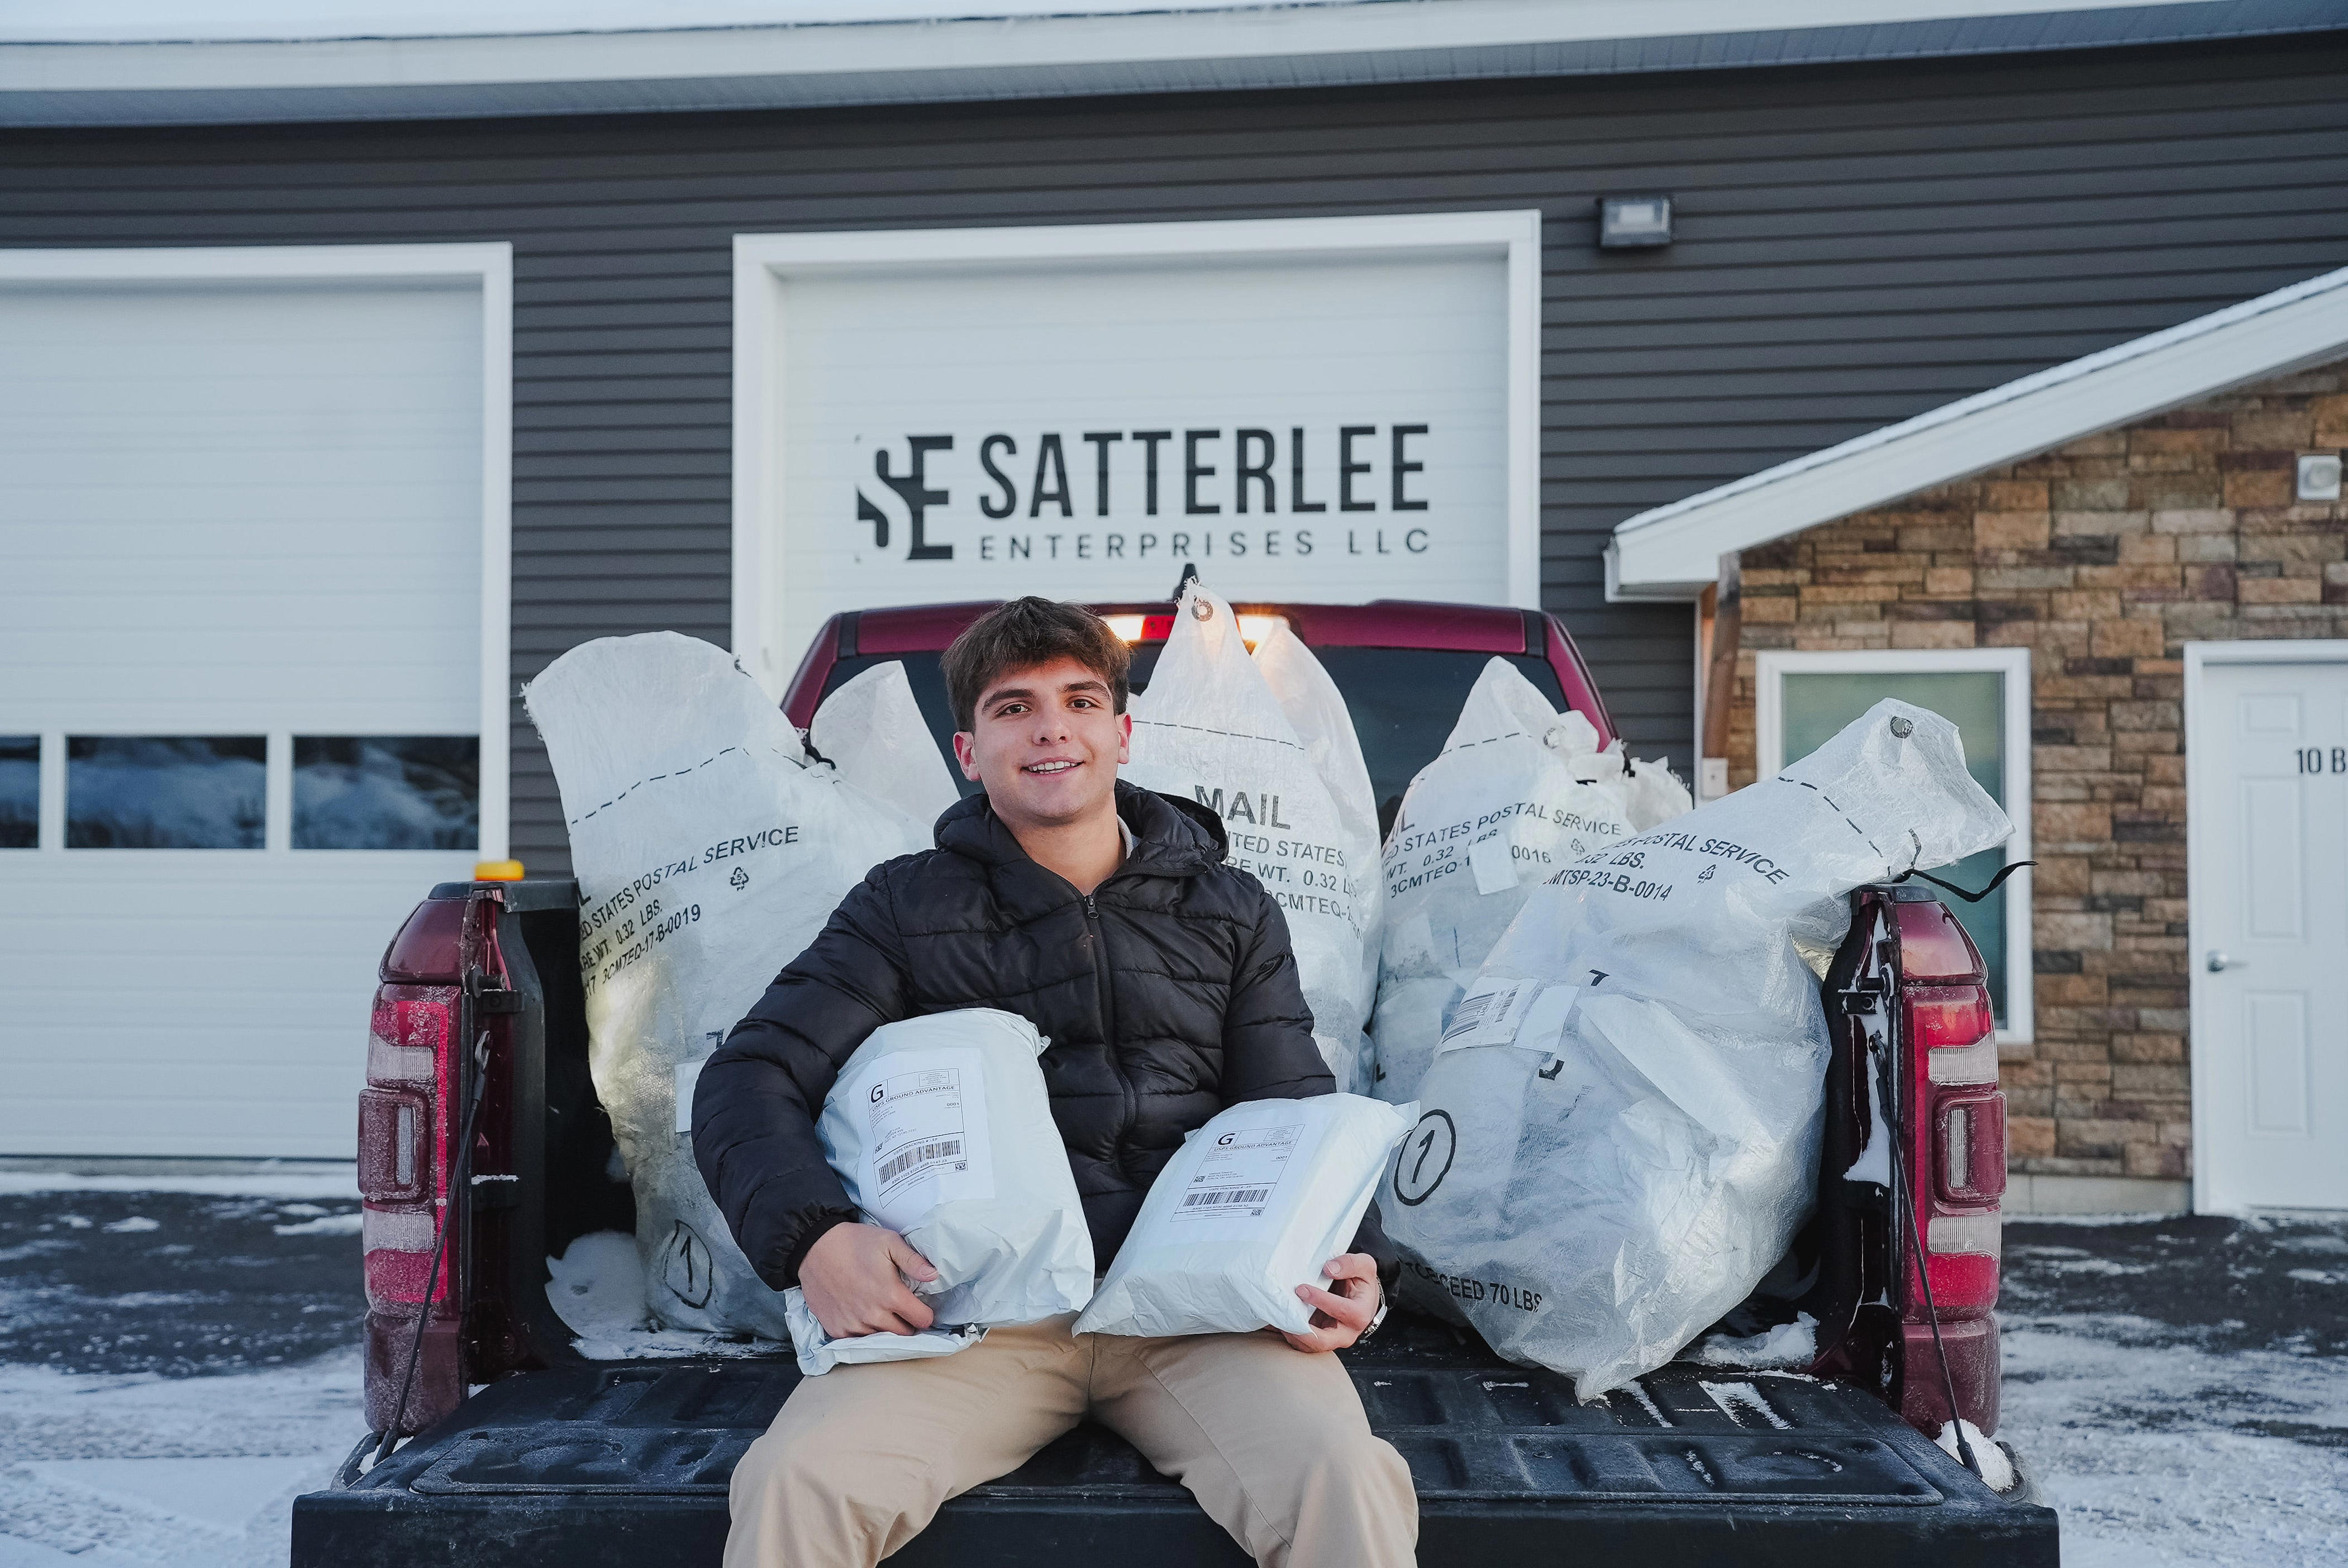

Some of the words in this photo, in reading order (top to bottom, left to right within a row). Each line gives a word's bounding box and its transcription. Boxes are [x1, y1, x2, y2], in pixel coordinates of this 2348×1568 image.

[979, 424, 1428, 519] SATTERLEE
[981, 530, 1313, 560] ENTERPRISES
[1347, 528, 1430, 554] LLC
[2296, 747, 2321, 774] 10
[1194, 784, 1290, 830] MAIL
[1404, 821, 1471, 852] STATES
[1477, 802, 1547, 830] POSTAL
[1552, 809, 1622, 836] SERVICE
[1276, 840, 1344, 867] STATES
[1423, 846, 1454, 866] 0.32
[1608, 852, 1645, 869] LBS.
[1699, 838, 1790, 885] SERVICE
[591, 887, 635, 928] STATES
[633, 855, 698, 897] POSTAL
[703, 826, 799, 864] SERVICE
[1258, 862, 1290, 883] WT.
[1303, 870, 1337, 892] 0.32
[615, 919, 635, 945] 0.32
[640, 899, 662, 926] LBS.
[870, 1084, 883, 1103] G
[872, 1101, 884, 1112] USPS
[885, 1091, 913, 1103] GROUND
[915, 1085, 955, 1095] ADVANTAGE
[1218, 1133, 1236, 1146] G
[1490, 1283, 1509, 1305] 70
